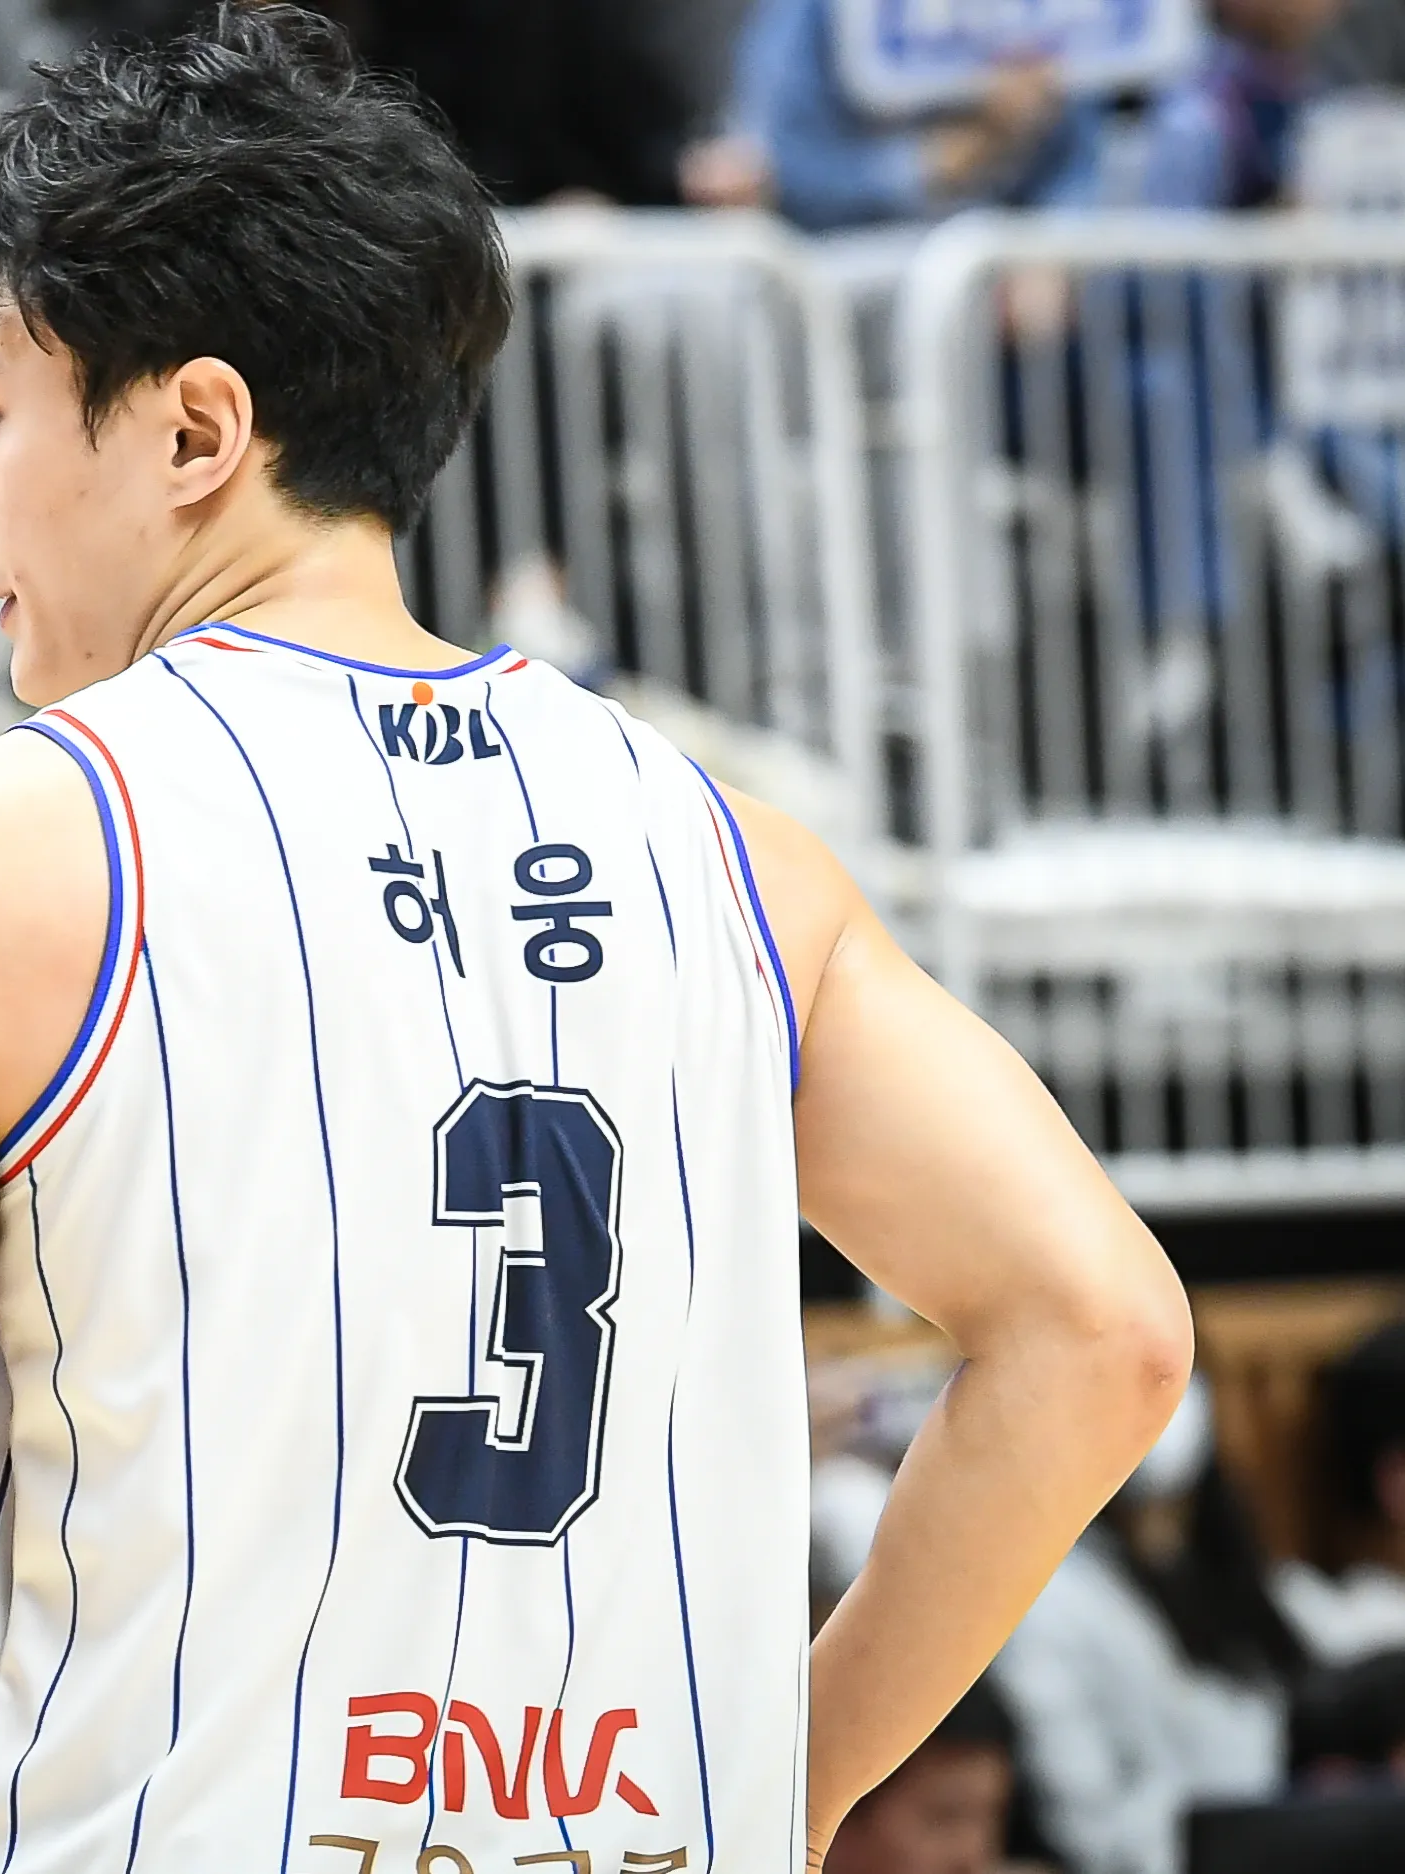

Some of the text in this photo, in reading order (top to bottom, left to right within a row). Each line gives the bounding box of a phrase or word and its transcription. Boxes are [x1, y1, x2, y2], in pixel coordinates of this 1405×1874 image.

[378, 703, 502, 765] KBL
[367, 842, 614, 983] 허웅
[393, 1077, 624, 1548] 3
[340, 1691, 660, 1820] BNK
